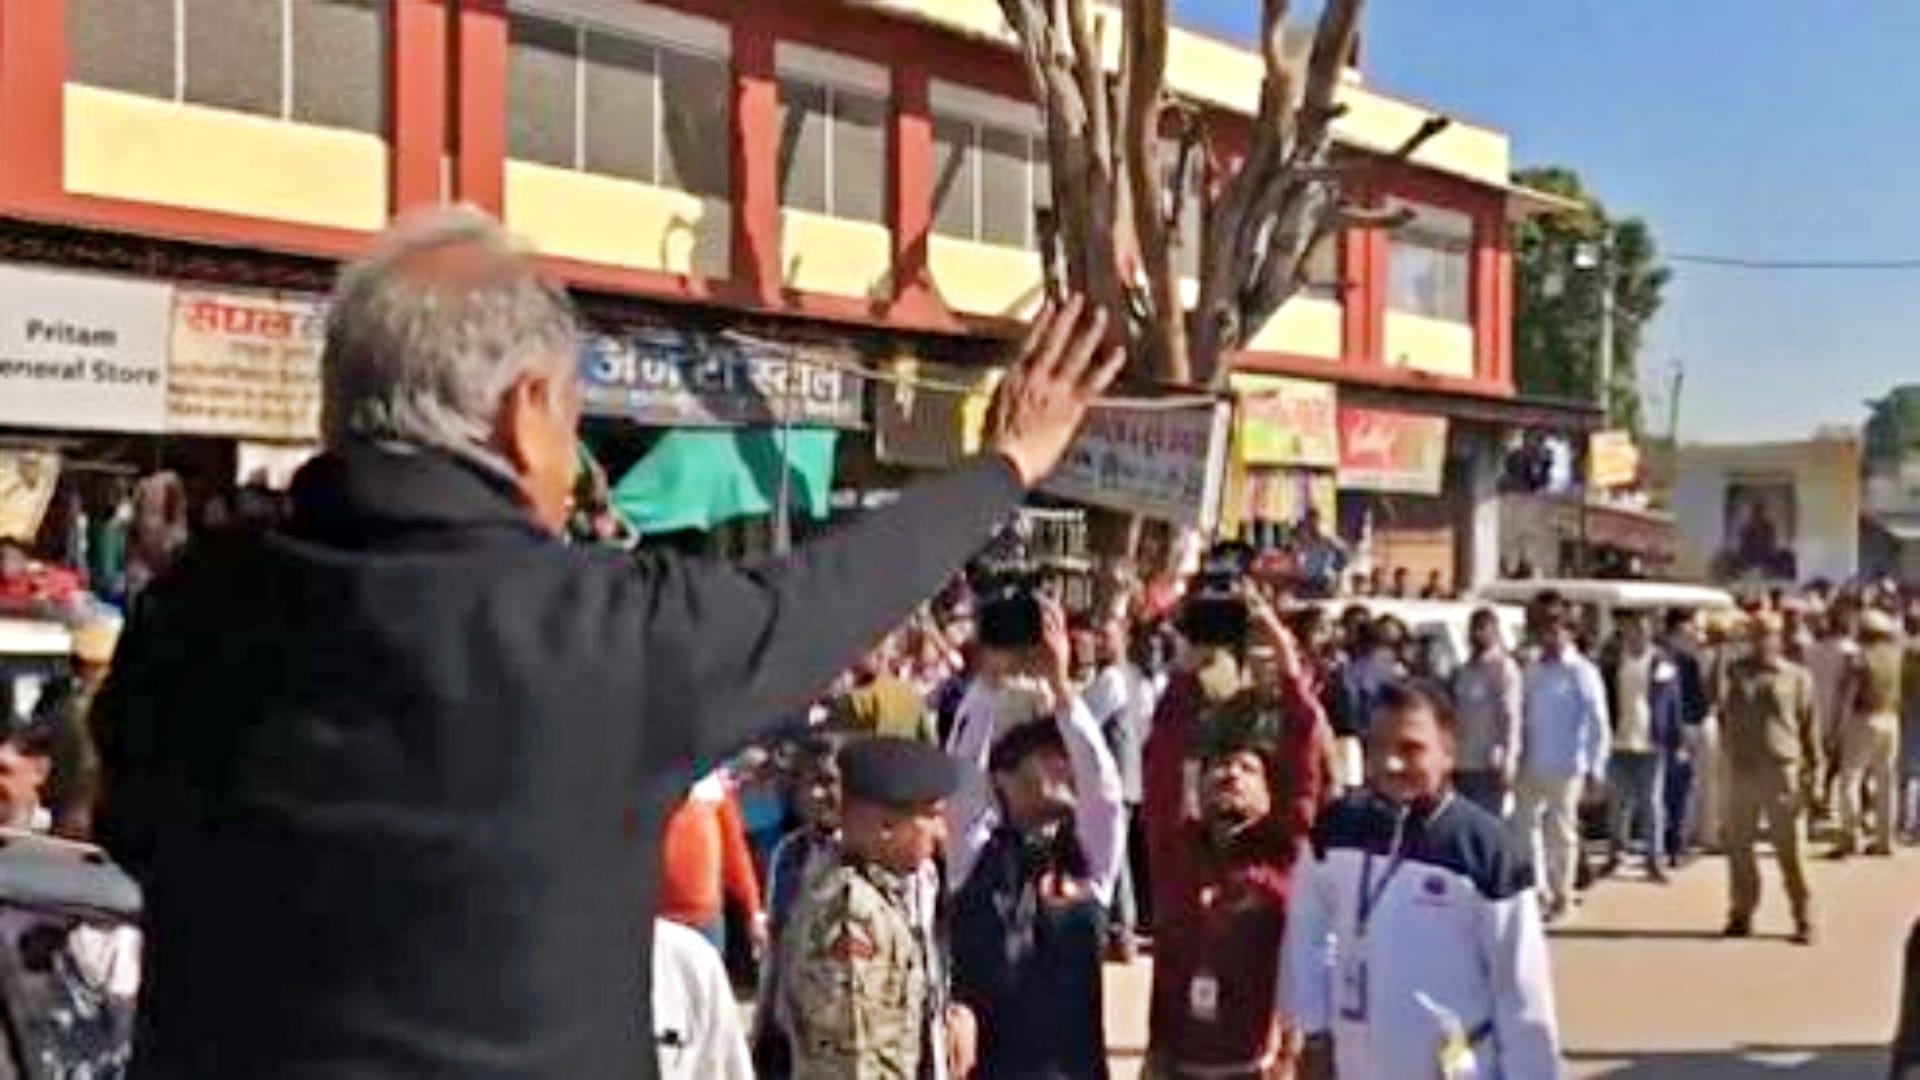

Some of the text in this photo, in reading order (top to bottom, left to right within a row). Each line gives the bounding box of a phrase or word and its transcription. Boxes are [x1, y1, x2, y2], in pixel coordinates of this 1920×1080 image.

[26, 319, 117, 346] Pritam
[0, 359, 86, 379] eneral
[92, 362, 160, 386] Store
